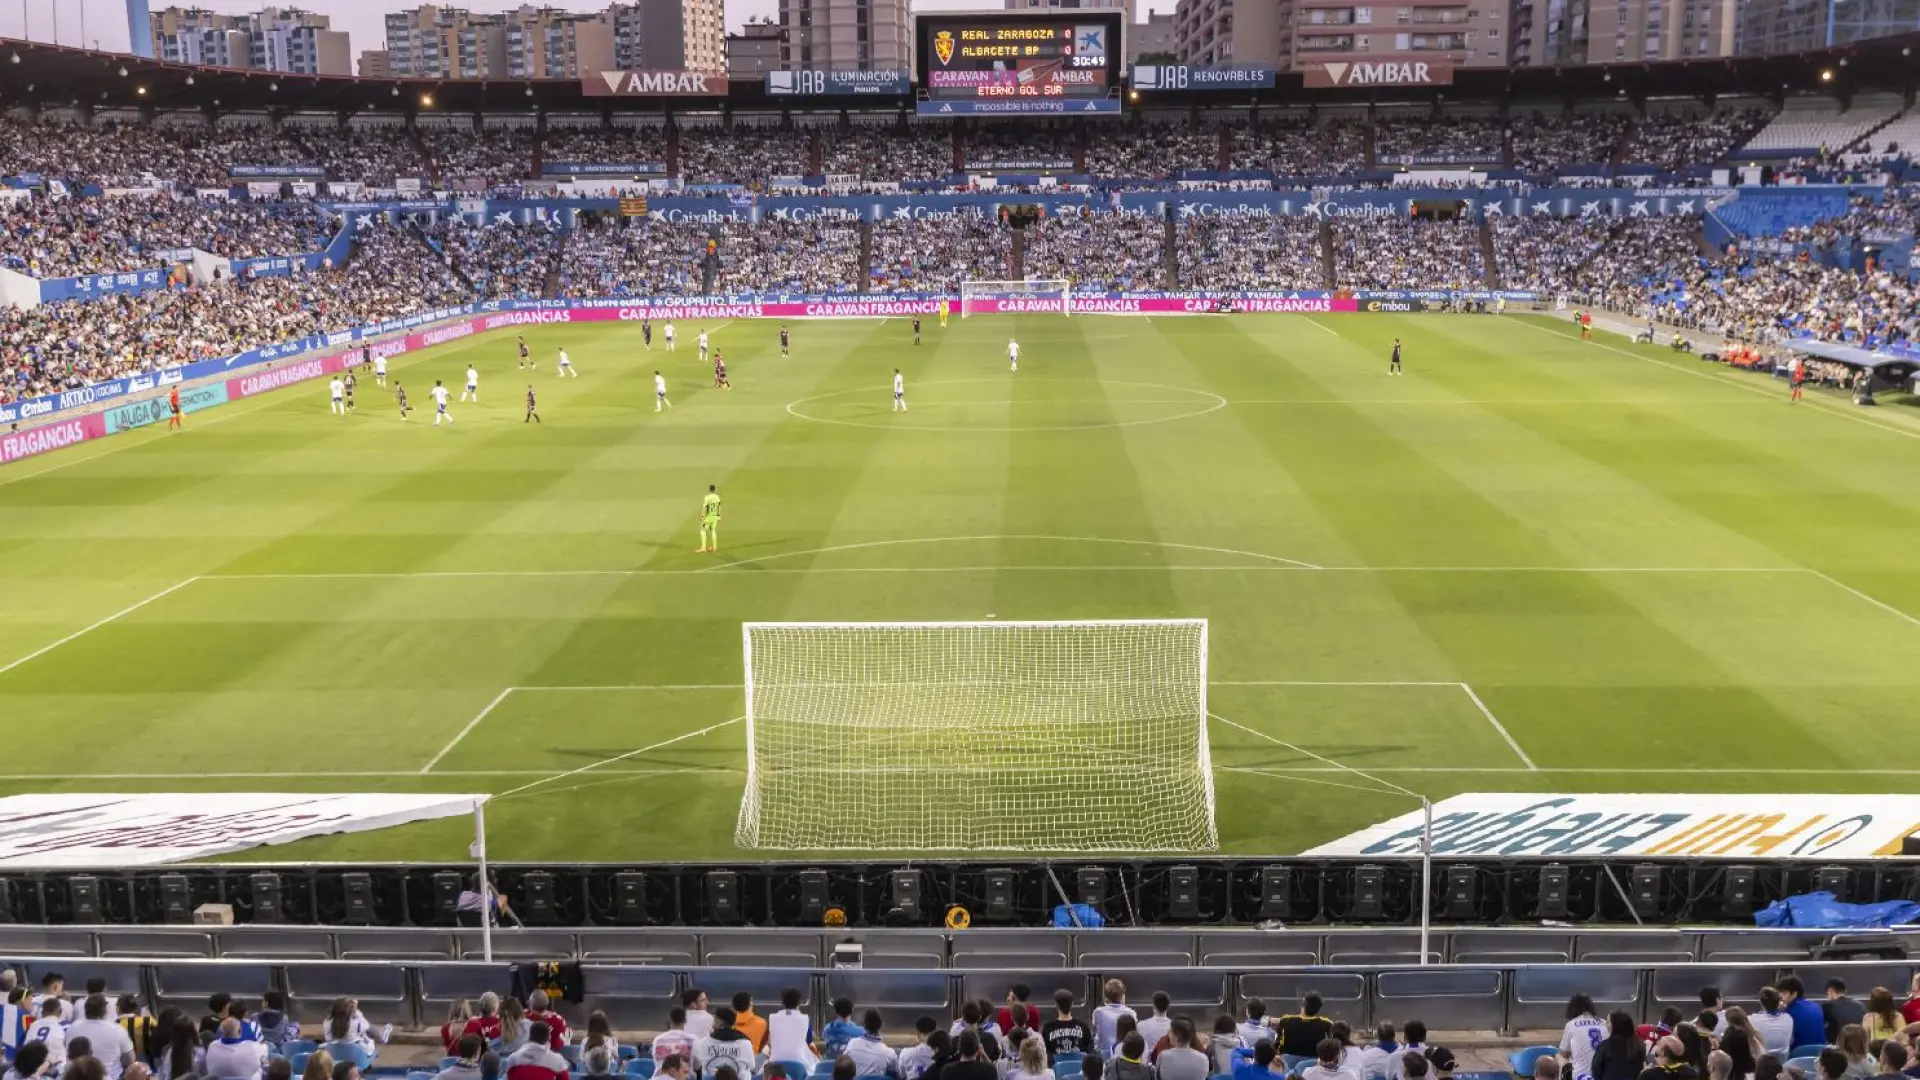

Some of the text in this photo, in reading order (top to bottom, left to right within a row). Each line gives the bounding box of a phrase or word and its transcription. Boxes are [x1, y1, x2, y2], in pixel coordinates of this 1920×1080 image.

[961, 30, 1071, 40] REAL ZARAGOZA 0
[961, 46, 1071, 57] ALBACETE BP 0
[1072, 57, 1105, 67] 30:49
[934, 71, 989, 81] CARAVAN
[1051, 71, 1094, 82] AMBAR
[1156, 65, 1264, 89] JAB RENOVABLES
[1347, 62, 1431, 83] AMBAR
[627, 73, 708, 93] AMBAR
[794, 68, 899, 94] JAB ILUMINACIÓN
[978, 85, 1062, 95] ETERNO GOL SUR
[973, 101, 1064, 112] impossible is nothing
[669, 208, 742, 224] CaixaBank
[1200, 203, 1271, 217] CaixaBank
[1323, 202, 1396, 217] CaixaBank
[860, 295, 897, 303] ROMERO
[998, 300, 1140, 311] CARAVAN RAGANCIAS
[1184, 299, 1331, 311] CARAN FRAGANCIAS
[1367, 301, 1410, 311] embou
[619, 306, 762, 320] CARAVAN FRAGANCIAS
[806, 303, 869, 315] CARAVAN
[241, 360, 323, 396] CARAVAN FRAGANCIAS
[60, 388, 94, 409] ARTICO
[0, 407, 17, 422] bou
[20, 398, 53, 417] embou
[113, 404, 150, 425] LALIGA
[3, 421, 84, 460] FRAGANCIAS
[37, 1026, 51, 1041] 9
